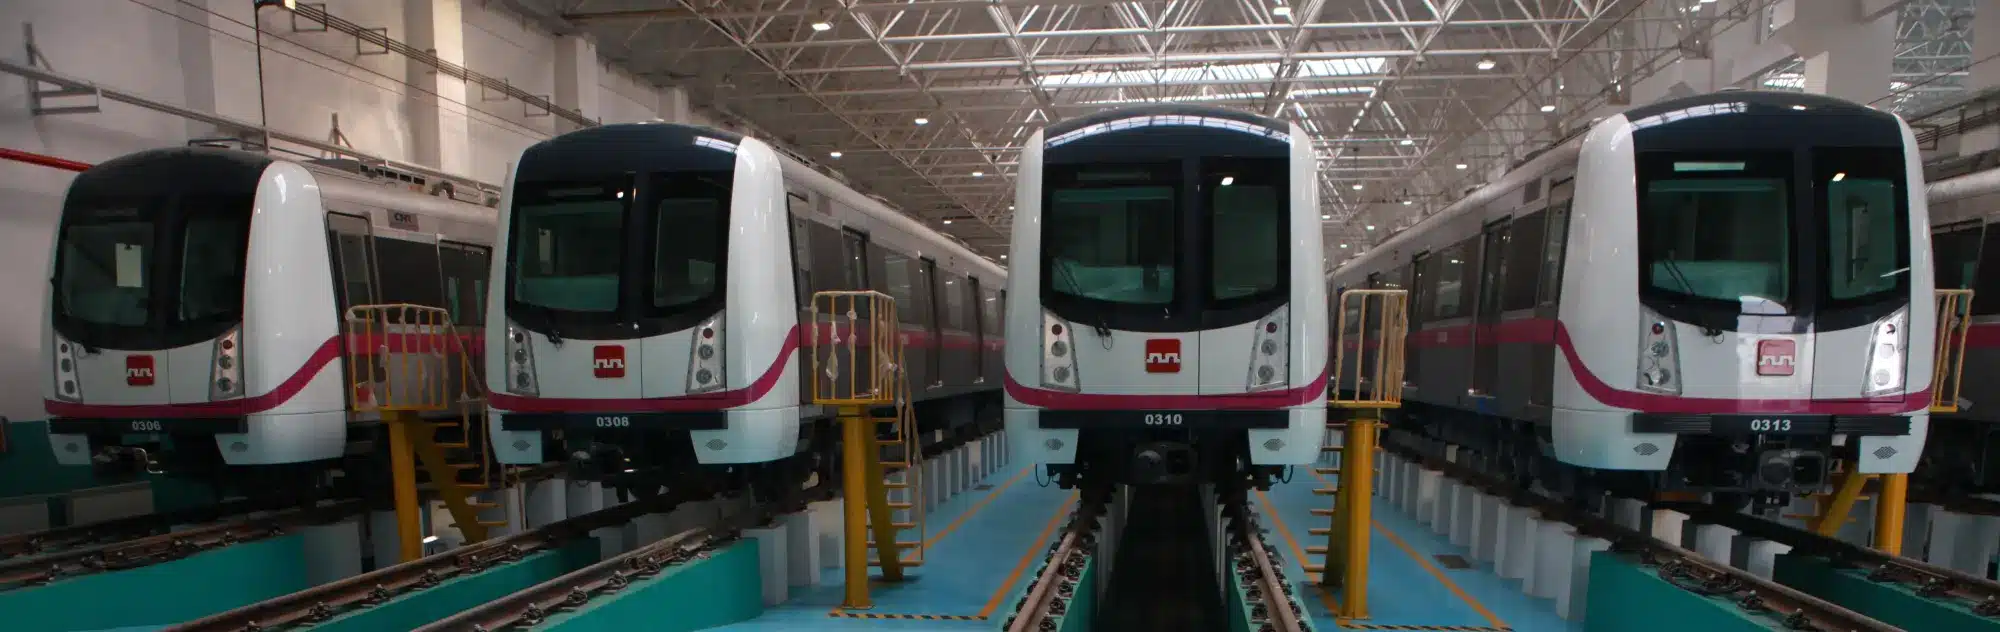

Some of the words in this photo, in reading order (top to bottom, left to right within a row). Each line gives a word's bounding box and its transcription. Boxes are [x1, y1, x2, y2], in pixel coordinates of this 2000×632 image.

[596, 416, 629, 427] 0308
[1145, 413, 1183, 425] 0310
[1751, 419, 1791, 431] 0313
